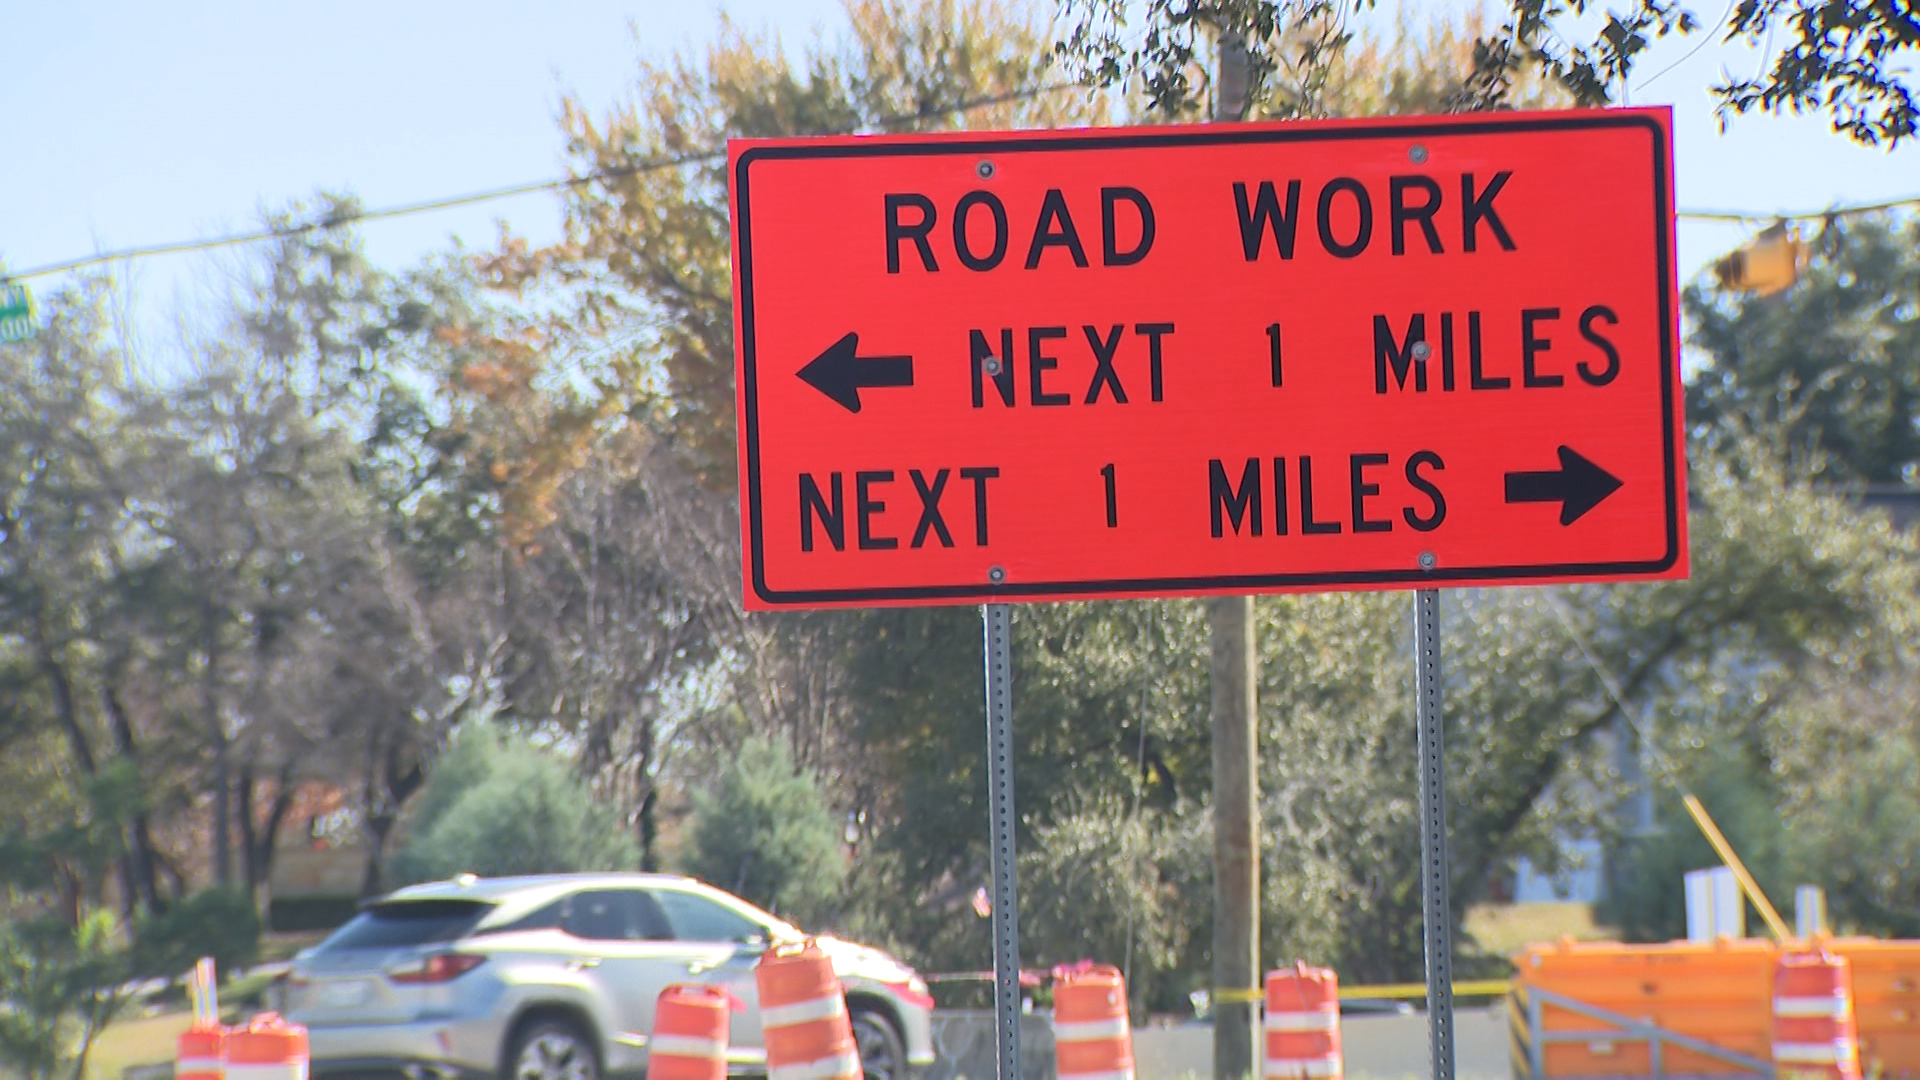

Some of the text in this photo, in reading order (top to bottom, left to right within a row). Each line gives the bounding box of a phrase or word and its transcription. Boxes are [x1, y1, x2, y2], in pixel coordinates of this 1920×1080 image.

[884, 171, 1516, 274] ROAD WORK
[969, 306, 1620, 408] NEXT 1 MILES
[799, 450, 1447, 552] NEXT 1 MILES
